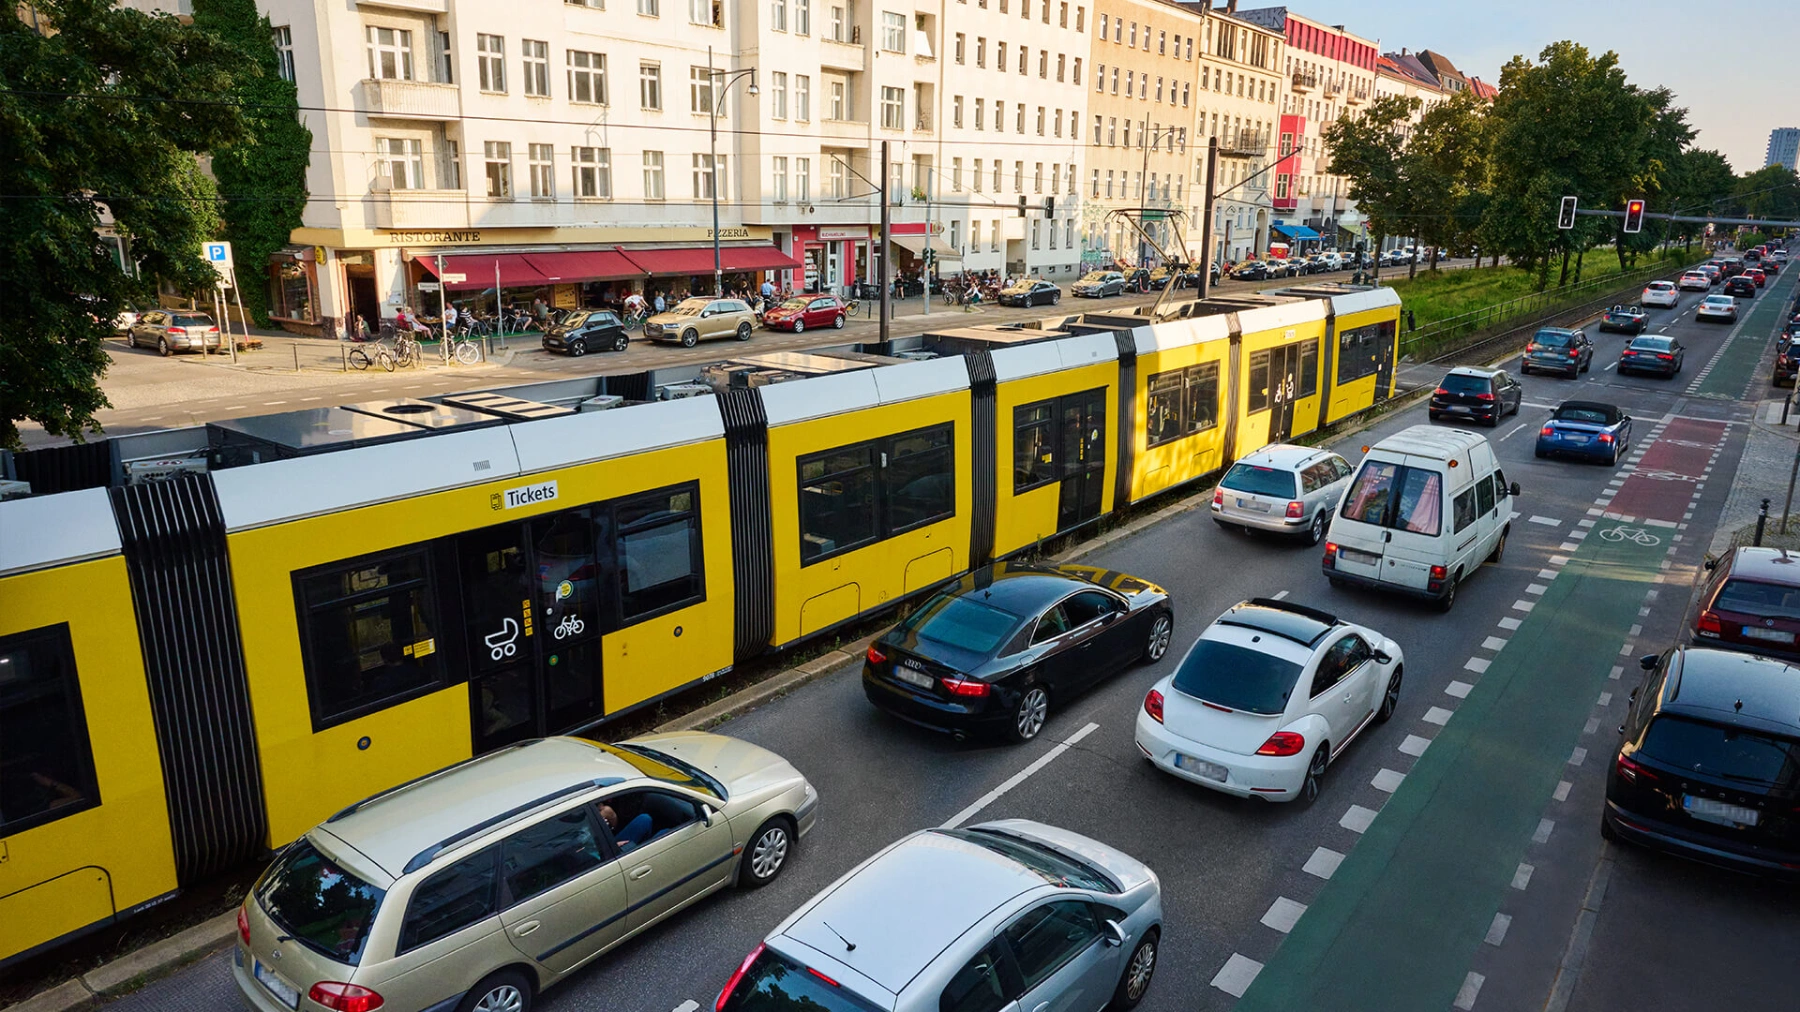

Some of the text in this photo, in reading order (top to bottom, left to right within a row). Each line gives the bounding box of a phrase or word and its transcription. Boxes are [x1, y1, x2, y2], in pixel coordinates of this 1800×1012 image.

[390, 231, 480, 243] RISTORANTE
[707, 228, 749, 238] PZZERIA
[212, 247, 222, 260] P
[507, 485, 555, 506] Tickets
